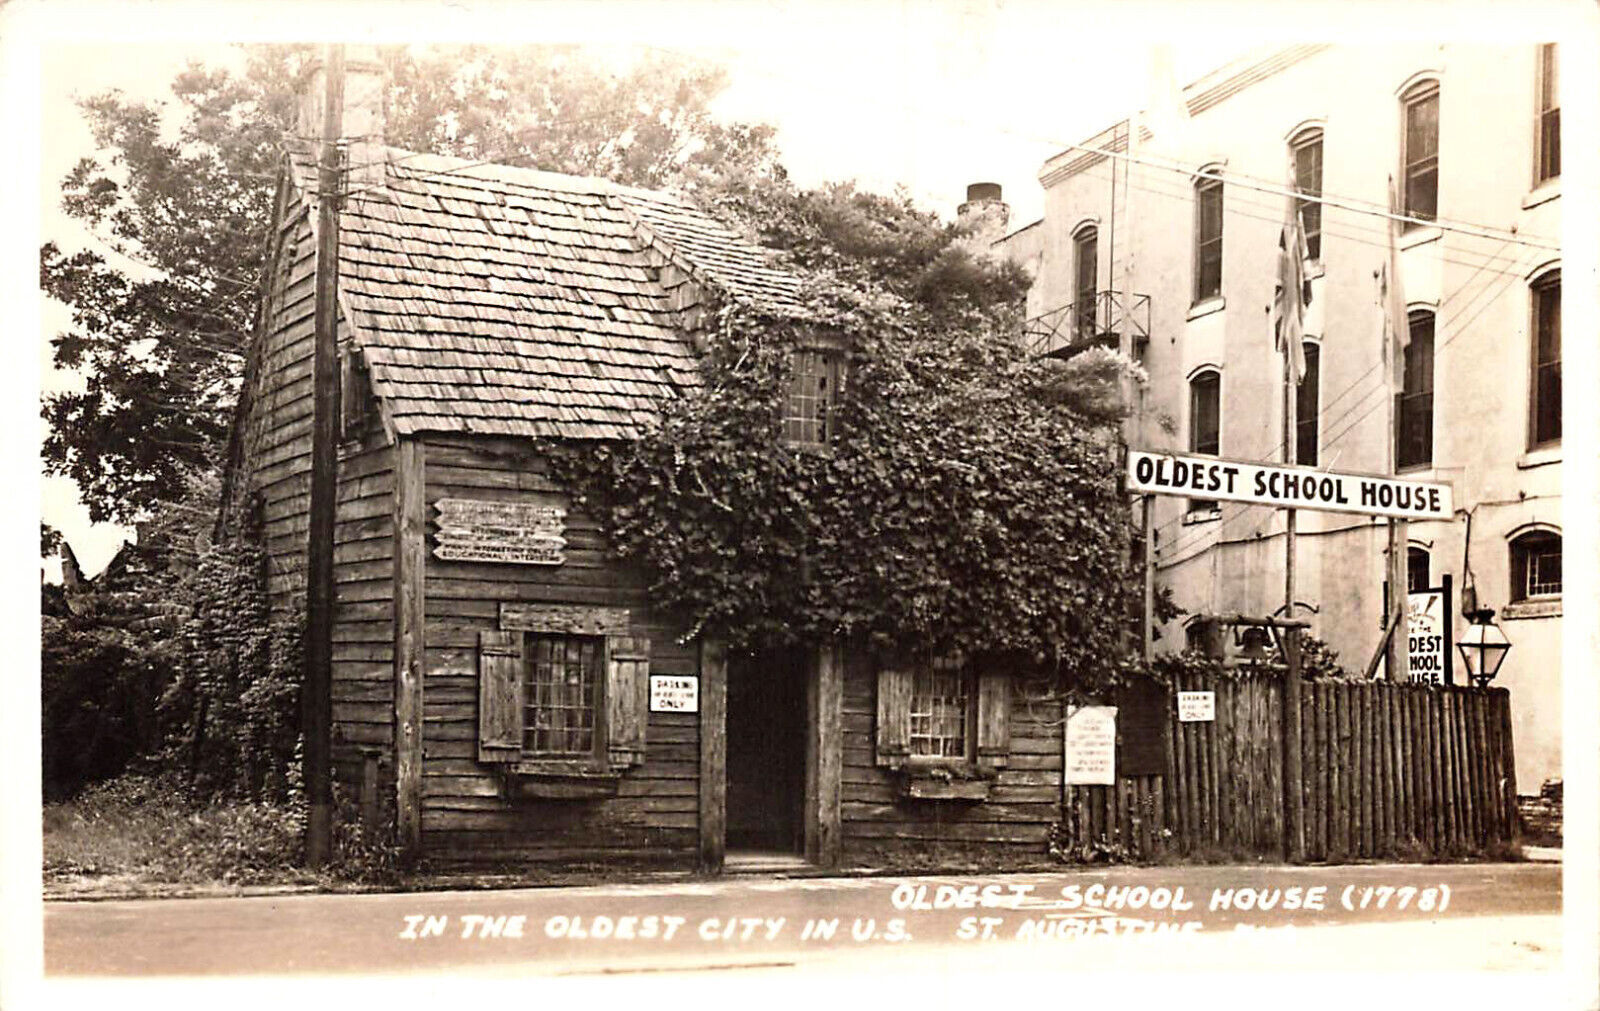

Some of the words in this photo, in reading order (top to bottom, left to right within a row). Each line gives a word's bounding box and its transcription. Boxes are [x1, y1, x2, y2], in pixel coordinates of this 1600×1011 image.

[1136, 456, 1239, 494] OLDEST
[1254, 470, 1348, 504] SCHOOL
[1361, 481, 1441, 512] HOUSE
[1408, 635, 1443, 653] DEST
[1409, 655, 1442, 671] HOOL
